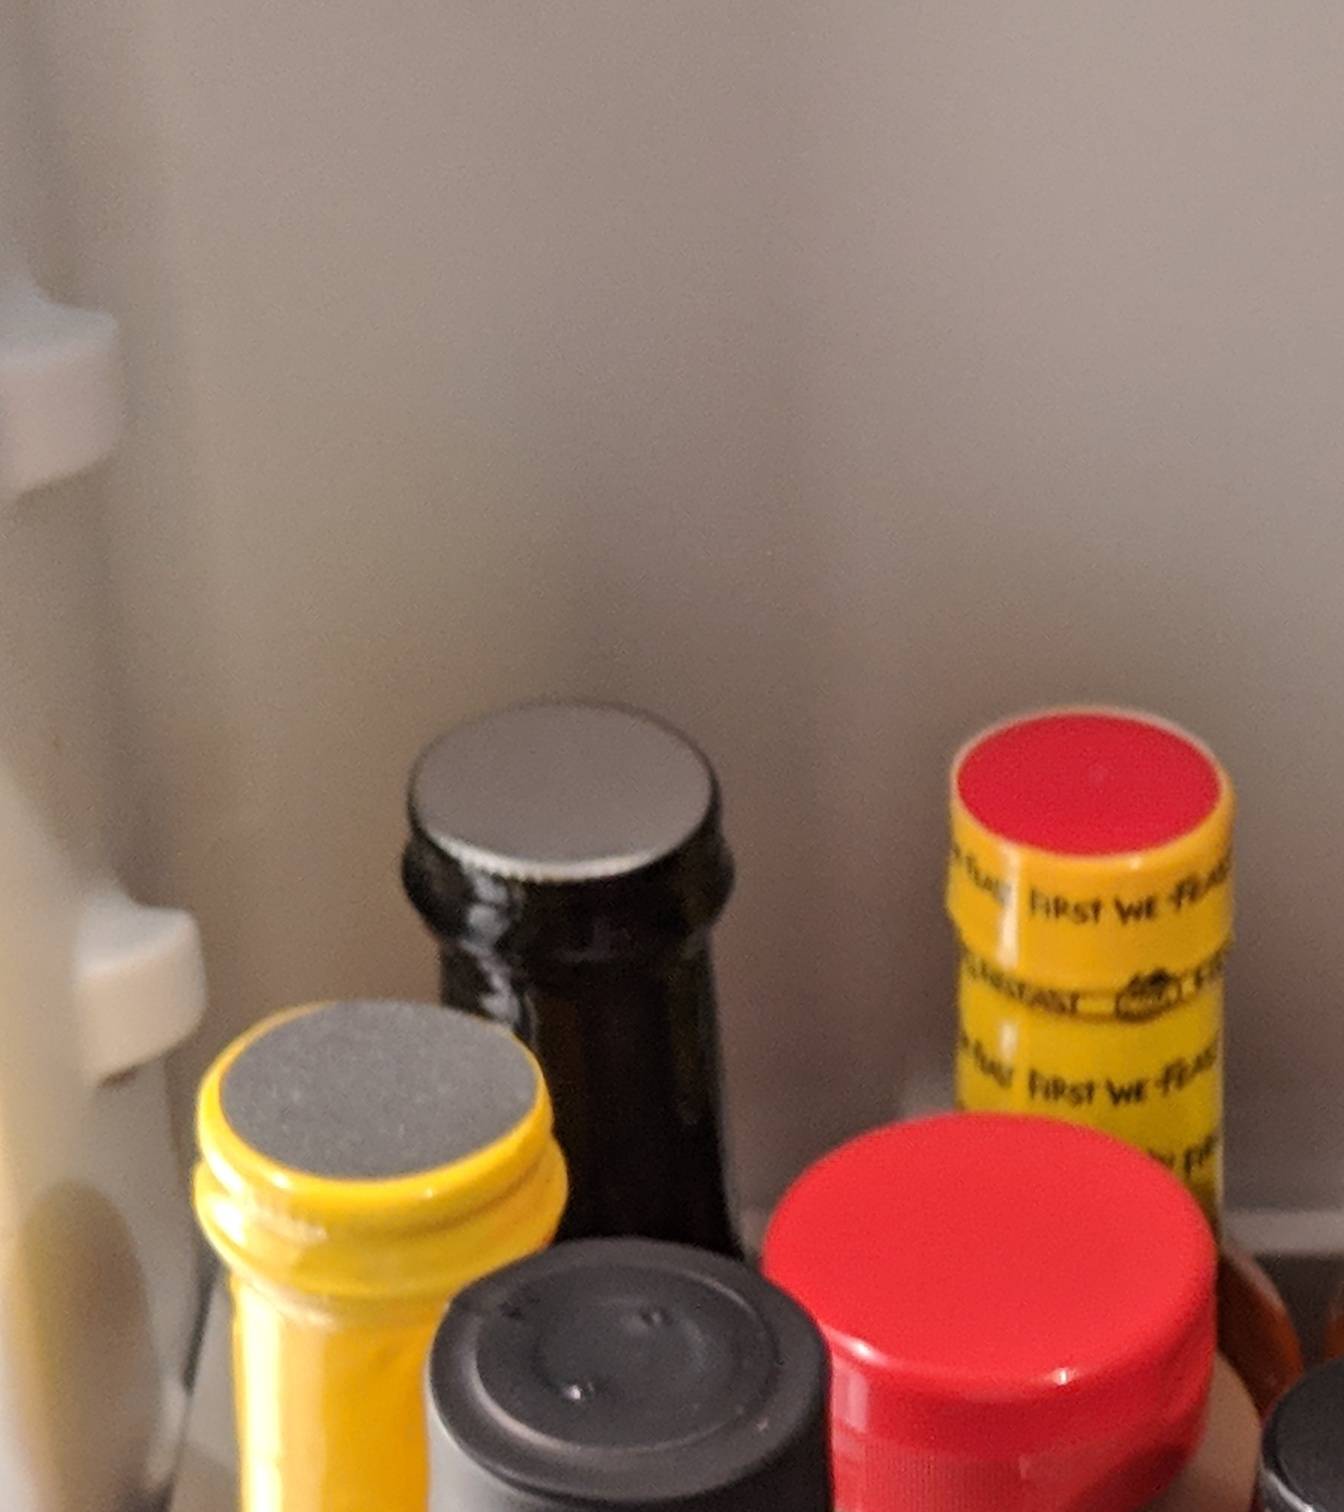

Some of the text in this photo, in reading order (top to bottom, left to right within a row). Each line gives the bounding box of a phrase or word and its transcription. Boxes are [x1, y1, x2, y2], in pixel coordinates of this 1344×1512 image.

[1029, 887, 1102, 924] FIRST
[1114, 895, 1157, 926] WE
[1027, 1068, 1096, 1109] FIRST
[1105, 1075, 1148, 1106] WE
